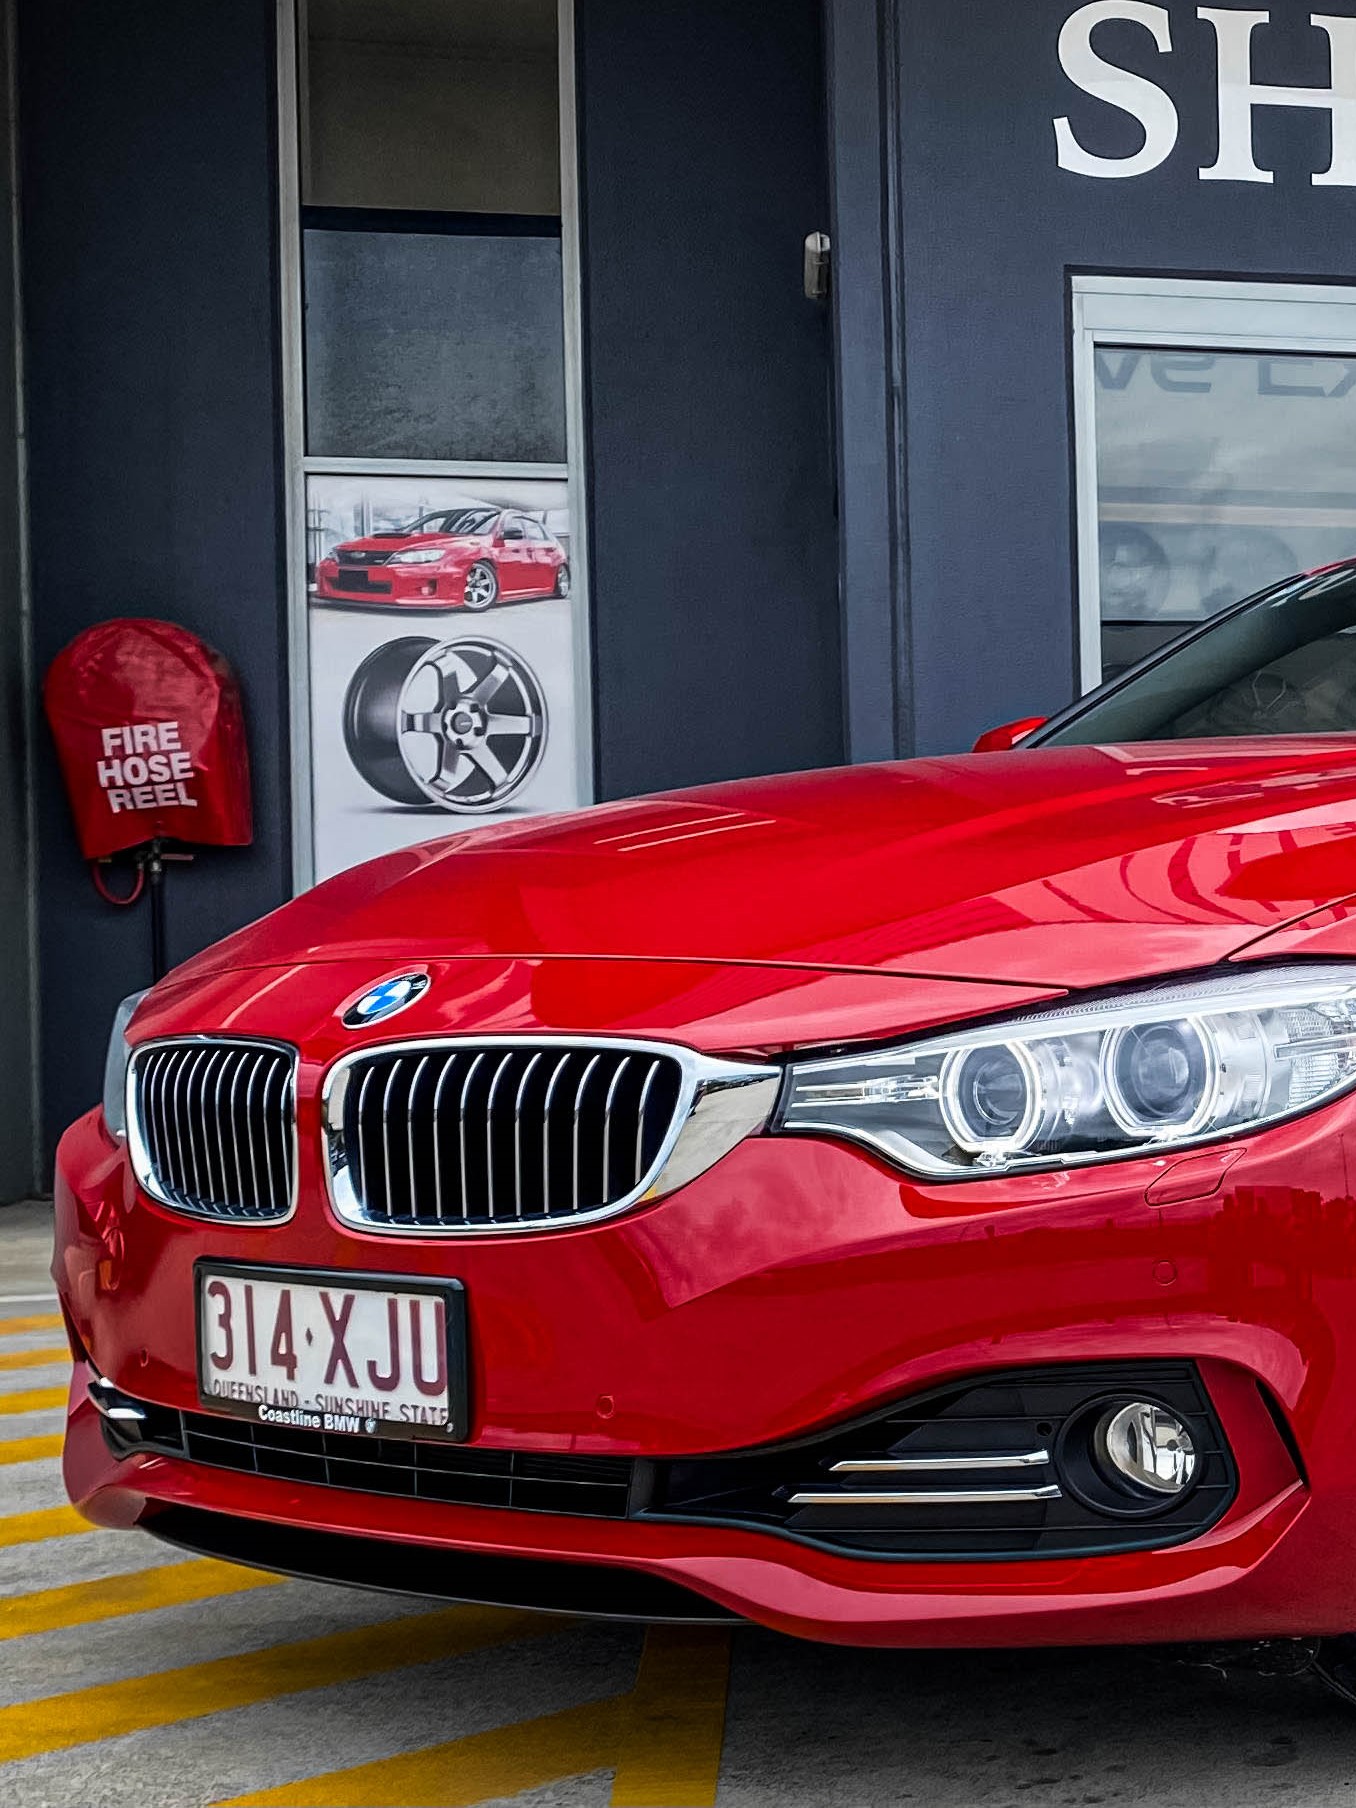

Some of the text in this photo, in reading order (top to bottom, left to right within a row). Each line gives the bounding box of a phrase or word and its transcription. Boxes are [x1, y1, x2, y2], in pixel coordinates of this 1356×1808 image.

[101, 721, 182, 756] FIRE
[97, 752, 195, 788] HOSE
[107, 782, 198, 813] REEL
[214, 1379, 299, 1407] QUEENSLAND
[315, 1393, 391, 1419] SUNSHINE
[400, 1404, 448, 1425] STATE
[258, 1404, 360, 1434] Coastline BMW
